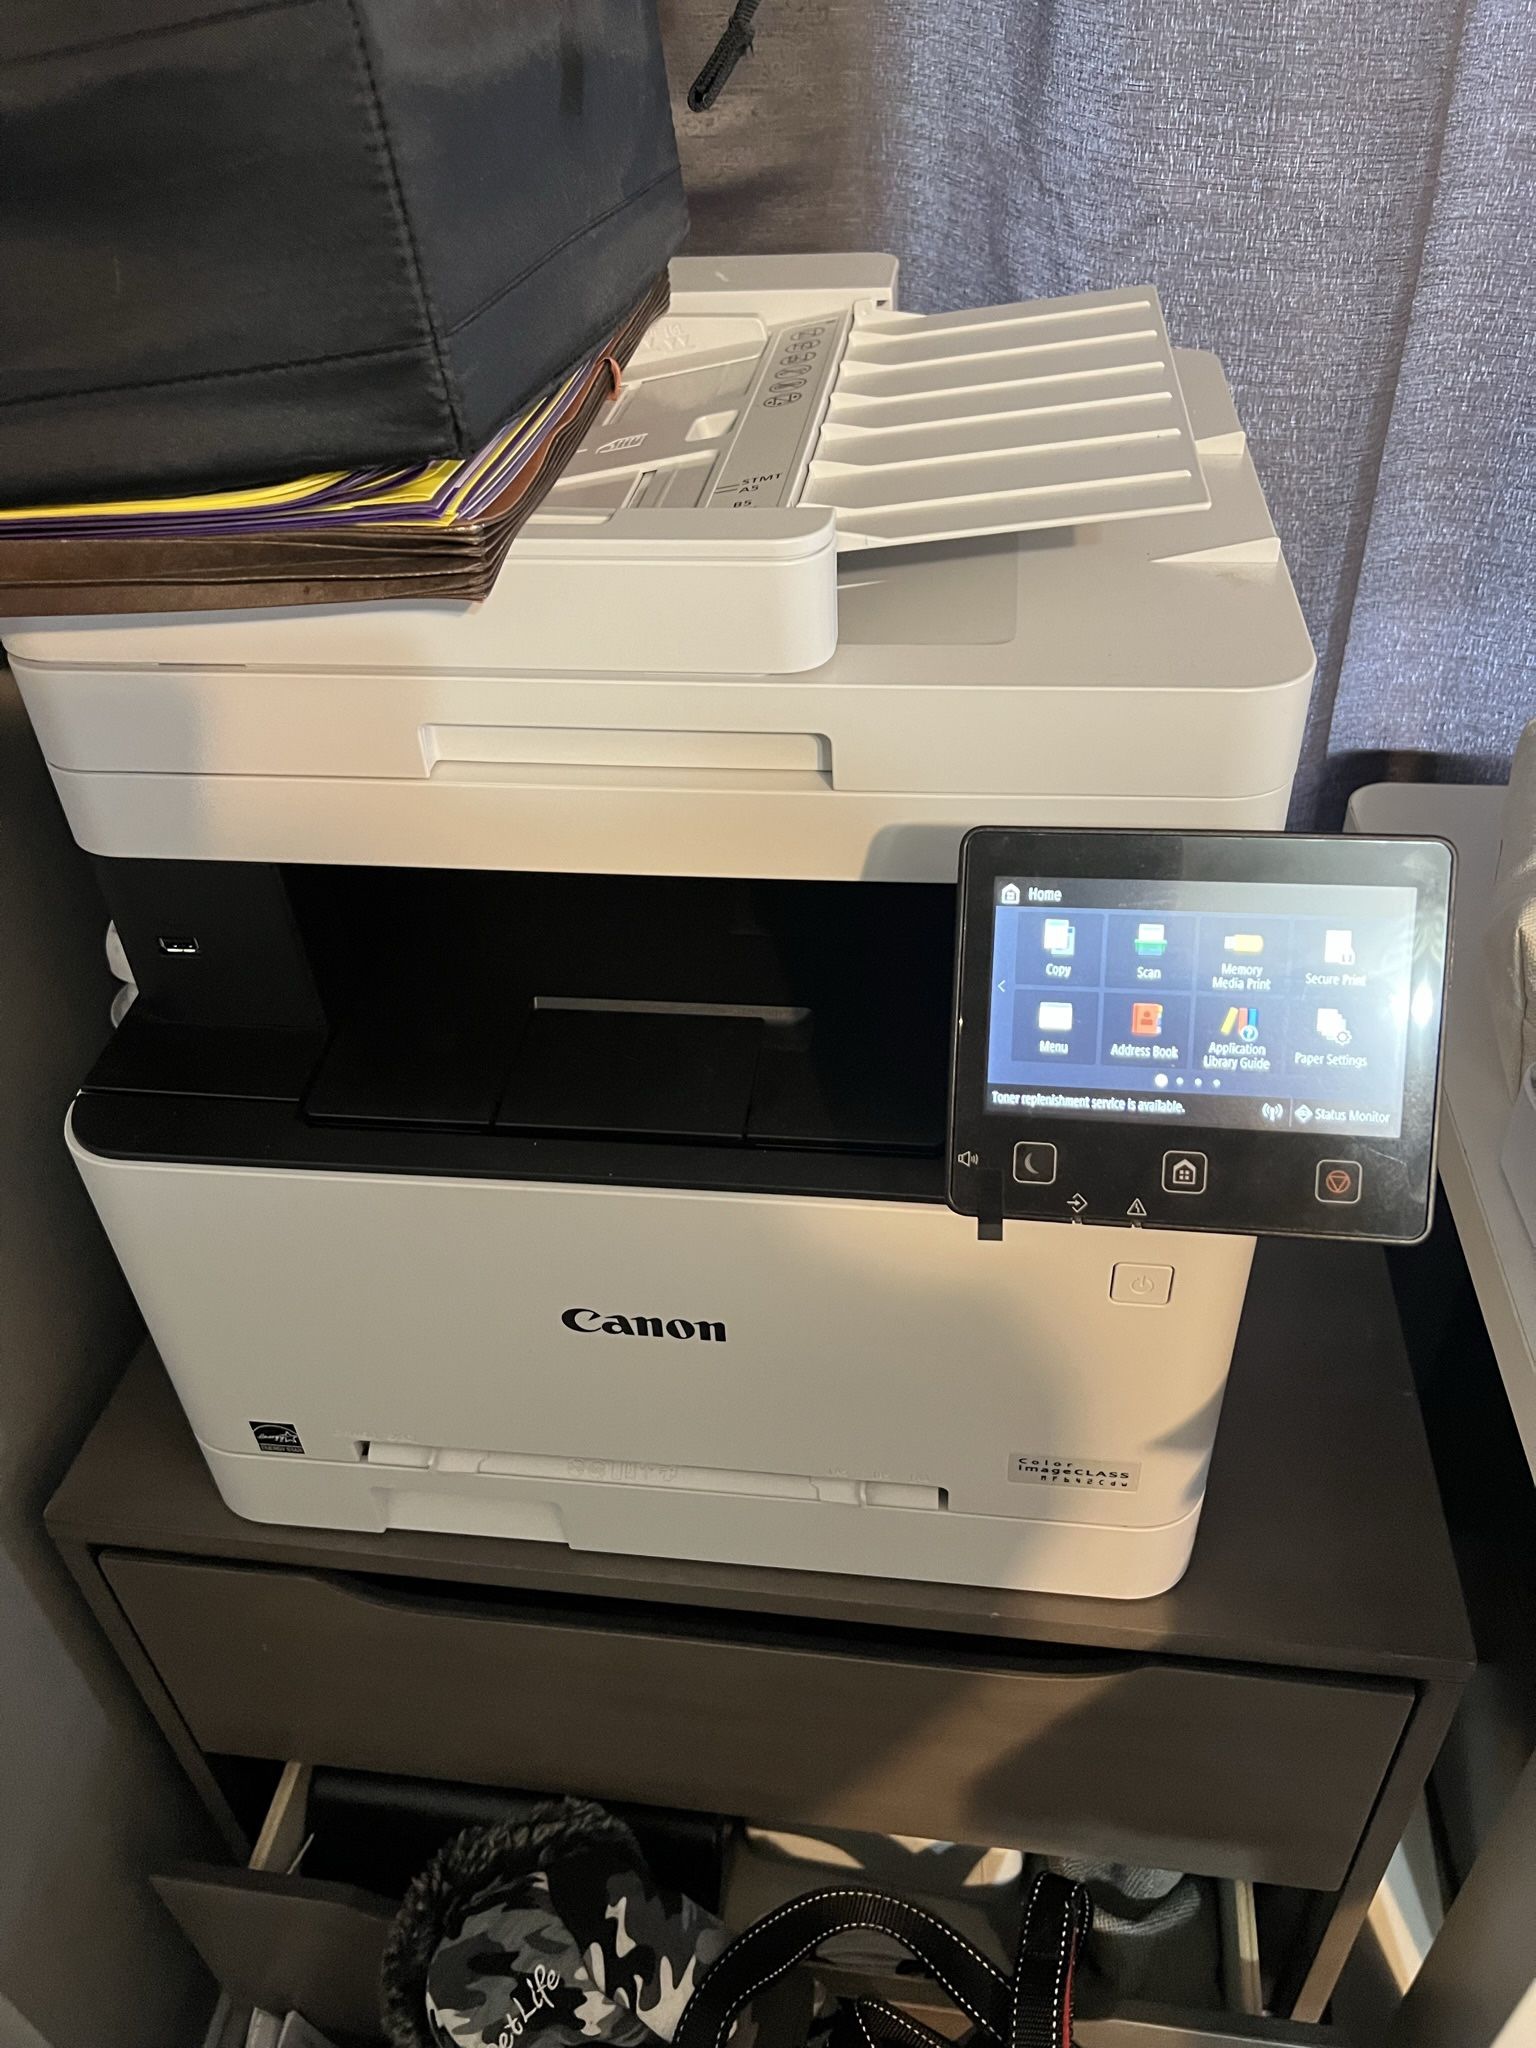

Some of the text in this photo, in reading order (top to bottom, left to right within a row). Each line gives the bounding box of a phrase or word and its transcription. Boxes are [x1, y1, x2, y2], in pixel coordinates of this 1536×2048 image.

[1028, 887, 1062, 902] Home
[1045, 963, 1072, 979] Copy
[1137, 966, 1162, 980] Scan
[1221, 963, 1263, 978] Memory
[1212, 976, 1271, 991] Media Print
[1305, 972, 1367, 987] Secure Print
[1039, 1040, 1069, 1055] Menu
[1110, 1043, 1179, 1059] Address Book
[1208, 1041, 1266, 1056] Application
[1203, 1055, 1271, 1071] Library Guide
[1294, 1051, 1368, 1070] Paper Settings
[991, 1090, 1186, 1114] Toner replenishment service is available.
[1315, 1107, 1391, 1124] Status Monitor
[561, 1308, 727, 1342] Canon
[1018, 1457, 1073, 1468] Color
